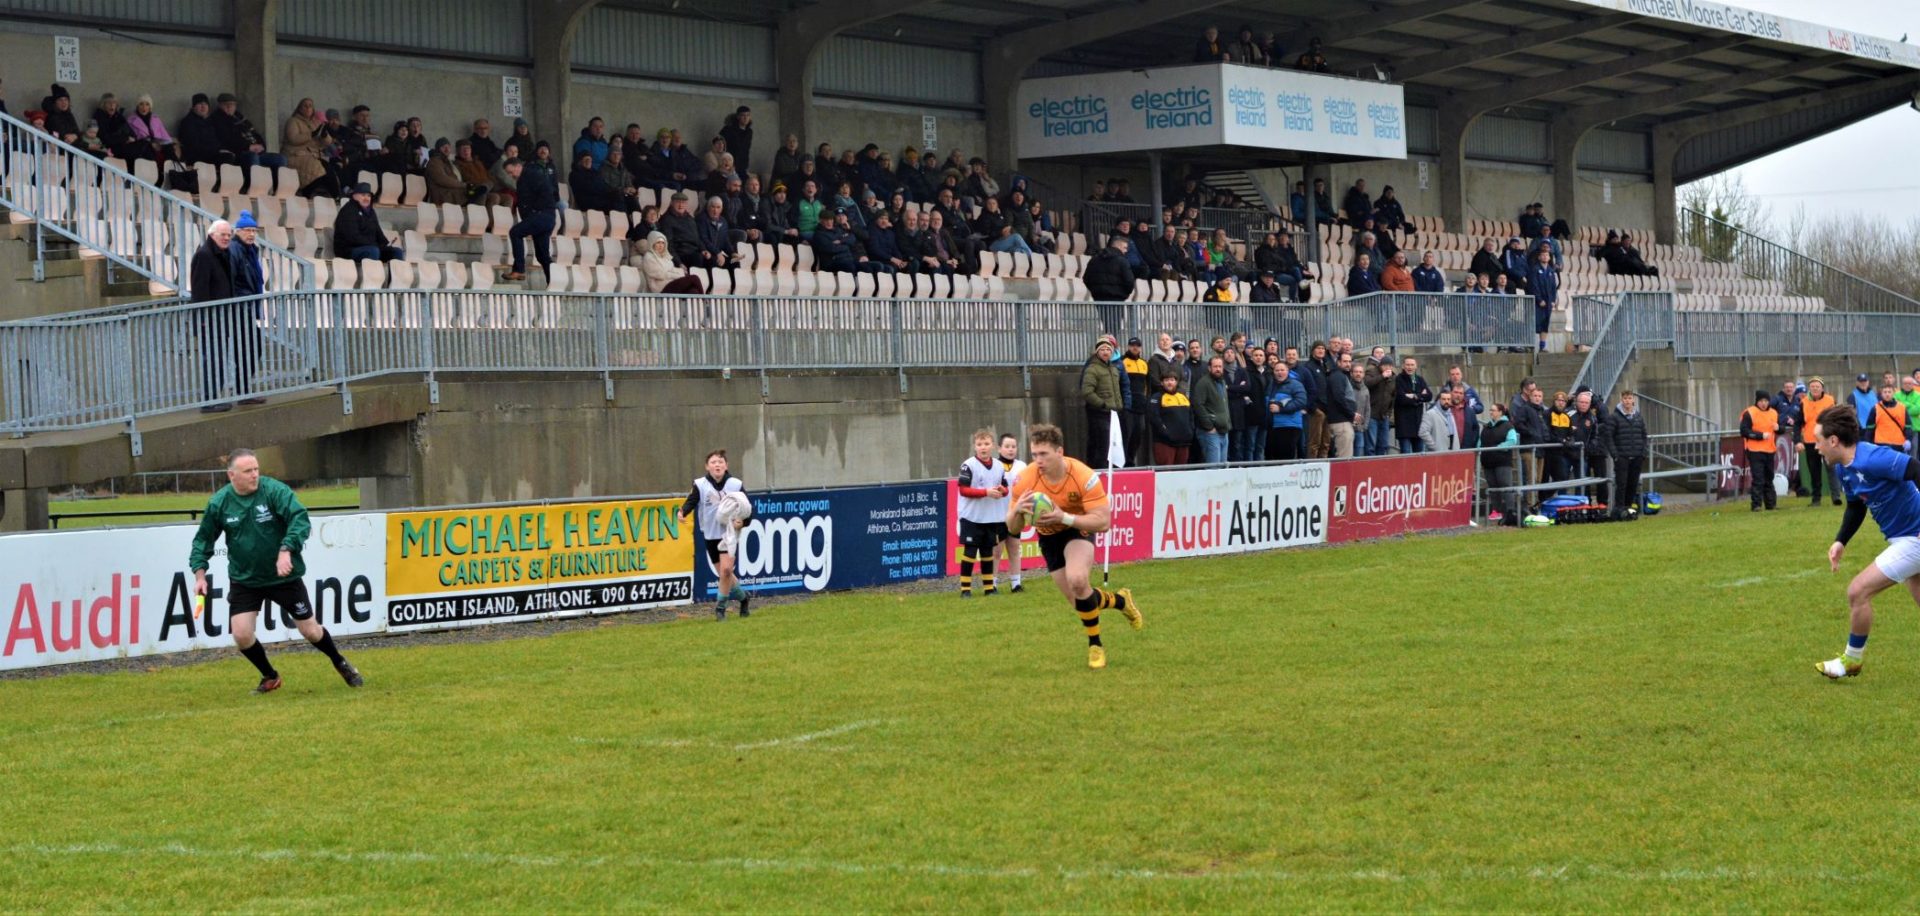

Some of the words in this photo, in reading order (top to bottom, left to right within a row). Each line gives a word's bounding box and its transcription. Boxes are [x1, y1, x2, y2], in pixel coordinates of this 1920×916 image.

[1682, 0, 1723, 27] Moore
[1726, 8, 1746, 31] Car
[1750, 12, 1782, 38] Sales
[1828, 30, 1852, 51] Audi
[1854, 36, 1891, 60] Athlone
[1029, 94, 1107, 117] electric
[1131, 86, 1210, 110] electric
[1228, 86, 1265, 108] electric
[1277, 91, 1312, 112] electric
[1323, 96, 1356, 117] electric
[1145, 105, 1212, 129] Ireland
[1236, 106, 1267, 127] Ireland
[1284, 111, 1313, 132] Ireland
[1368, 101, 1398, 122] electric
[1043, 112, 1109, 137] Ireland
[1330, 115, 1358, 136] Ireland
[1374, 120, 1400, 139] Ireland
[1355, 472, 1427, 518] Glenroyal
[1430, 468, 1469, 506] Hotel
[401, 513, 552, 558] MICHAEL
[564, 505, 680, 548] HEAVIN
[1160, 499, 1221, 551] Audi
[1228, 494, 1321, 546] Athlone
[1095, 524, 1134, 547] entre
[439, 556, 523, 586] CARPETS
[529, 559, 544, 580] &
[550, 547, 648, 578] FURNITURE
[902, 553, 912, 563] 090
[902, 566, 912, 577] 090
[392, 601, 456, 622] GOLDEN
[462, 596, 519, 616] ISLAND,
[524, 589, 597, 611] ATHLONE.
[602, 586, 625, 603] 090
[630, 580, 689, 600] 6474736
[2, 573, 140, 656] Audi
[159, 571, 372, 641] Atne
